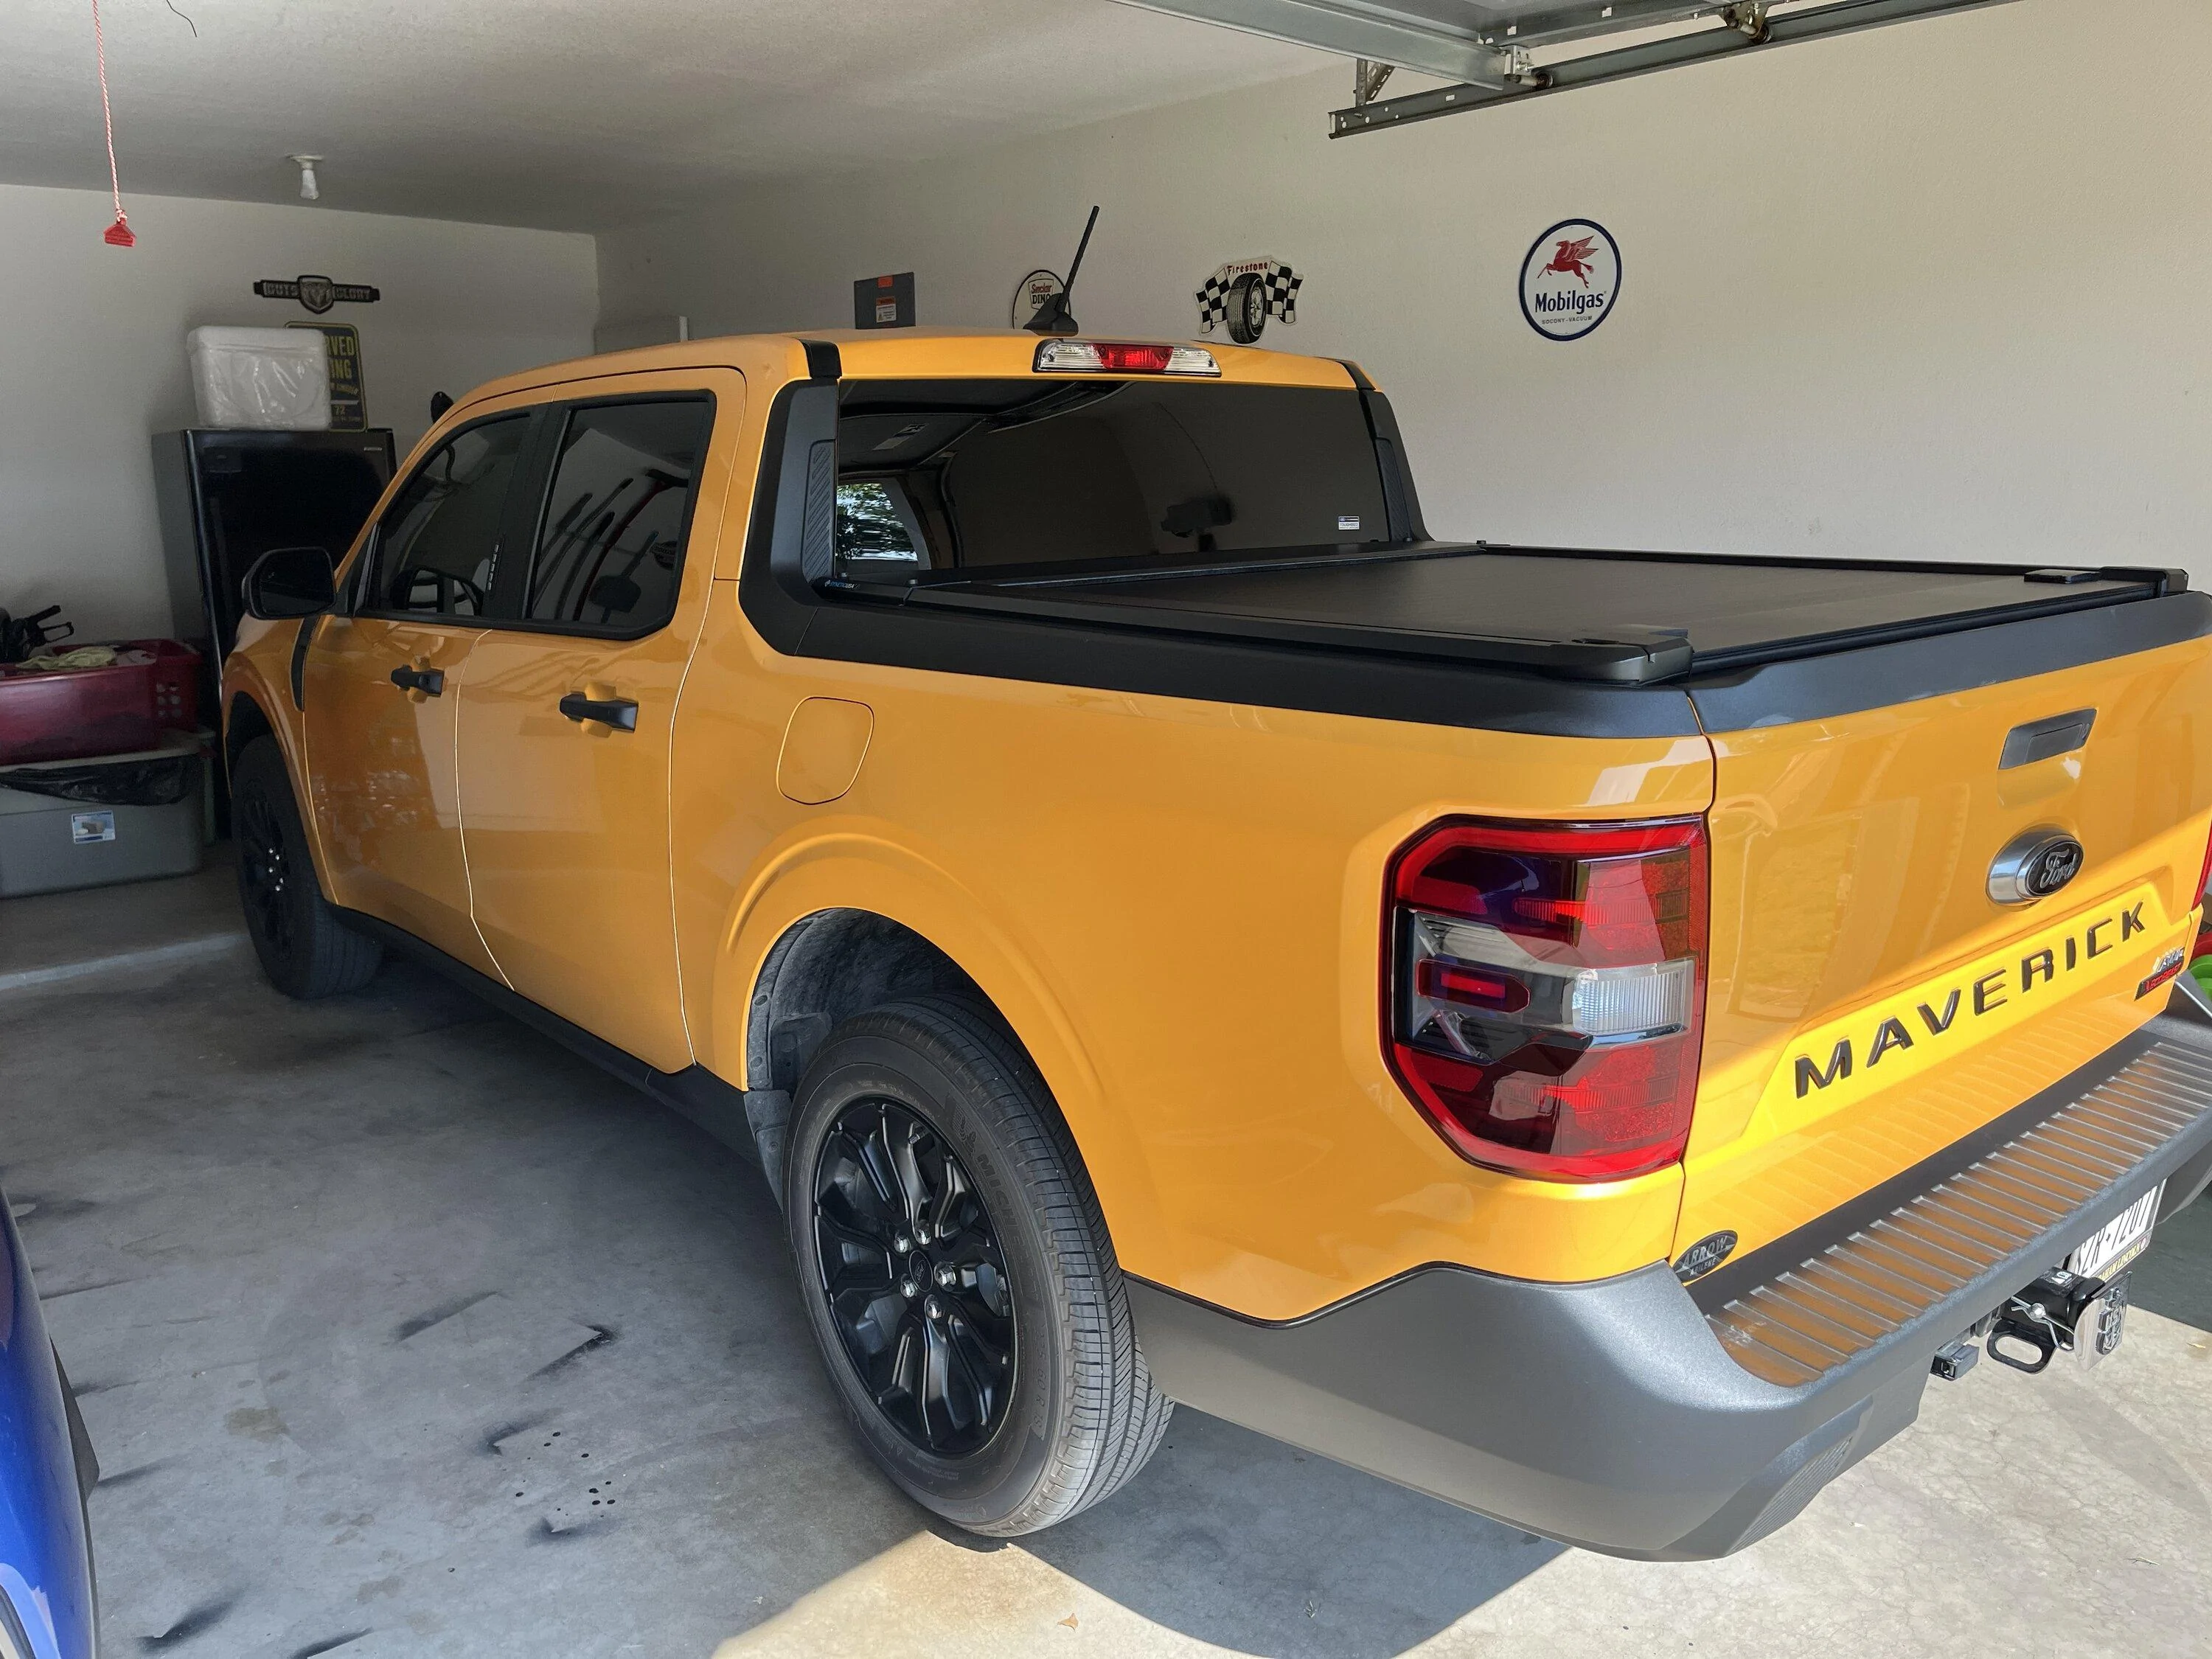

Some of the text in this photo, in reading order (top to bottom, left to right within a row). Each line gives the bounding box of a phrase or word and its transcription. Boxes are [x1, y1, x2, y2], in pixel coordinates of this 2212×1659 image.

[1226, 261, 1269, 275] Firestone
[1535, 290, 1604, 315] Mobilgas
[1542, 316, 1593, 324] SOCONY-VACUUM
[2039, 848, 2077, 888] Ford
[1795, 901, 2146, 1099] MAVERICK
[1681, 1235, 1728, 1267] ARROW
